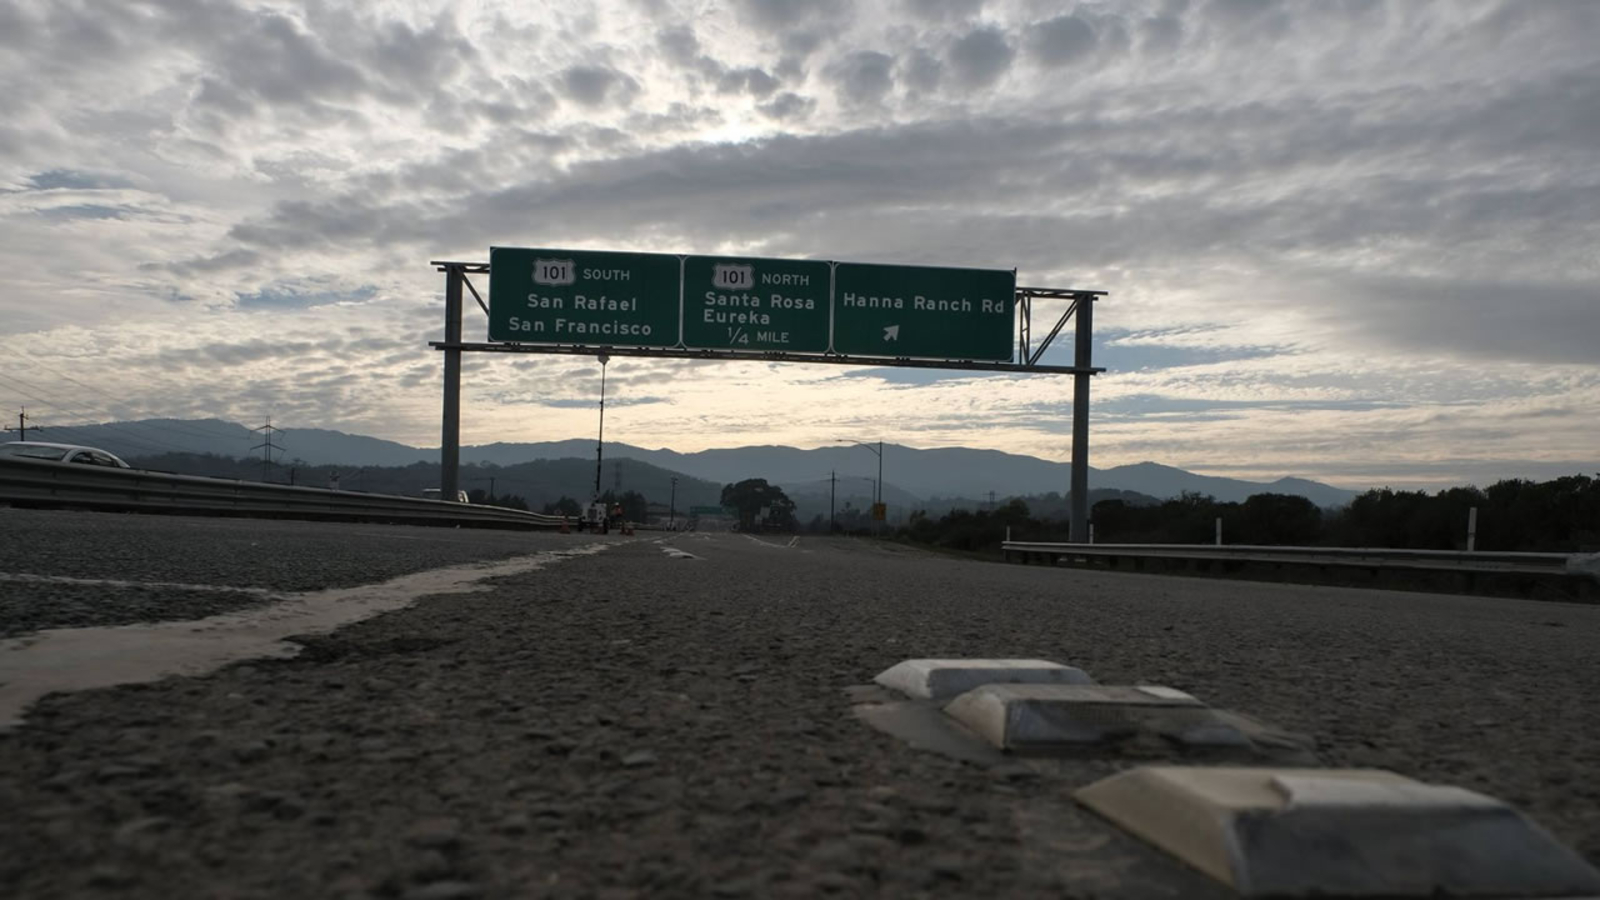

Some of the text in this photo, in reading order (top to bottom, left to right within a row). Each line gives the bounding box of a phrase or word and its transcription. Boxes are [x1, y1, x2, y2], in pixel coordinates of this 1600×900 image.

[542, 265, 630, 280] 101 SOUTH
[722, 270, 809, 285] 101 NORTH
[528, 294, 636, 311] San Rafael
[705, 292, 815, 310] Santa Rosa
[844, 293, 1004, 313] Hanna Ranch Rd
[704, 309, 770, 325] Eureka
[509, 317, 651, 336] San Francisco
[757, 332, 789, 343] MILE
